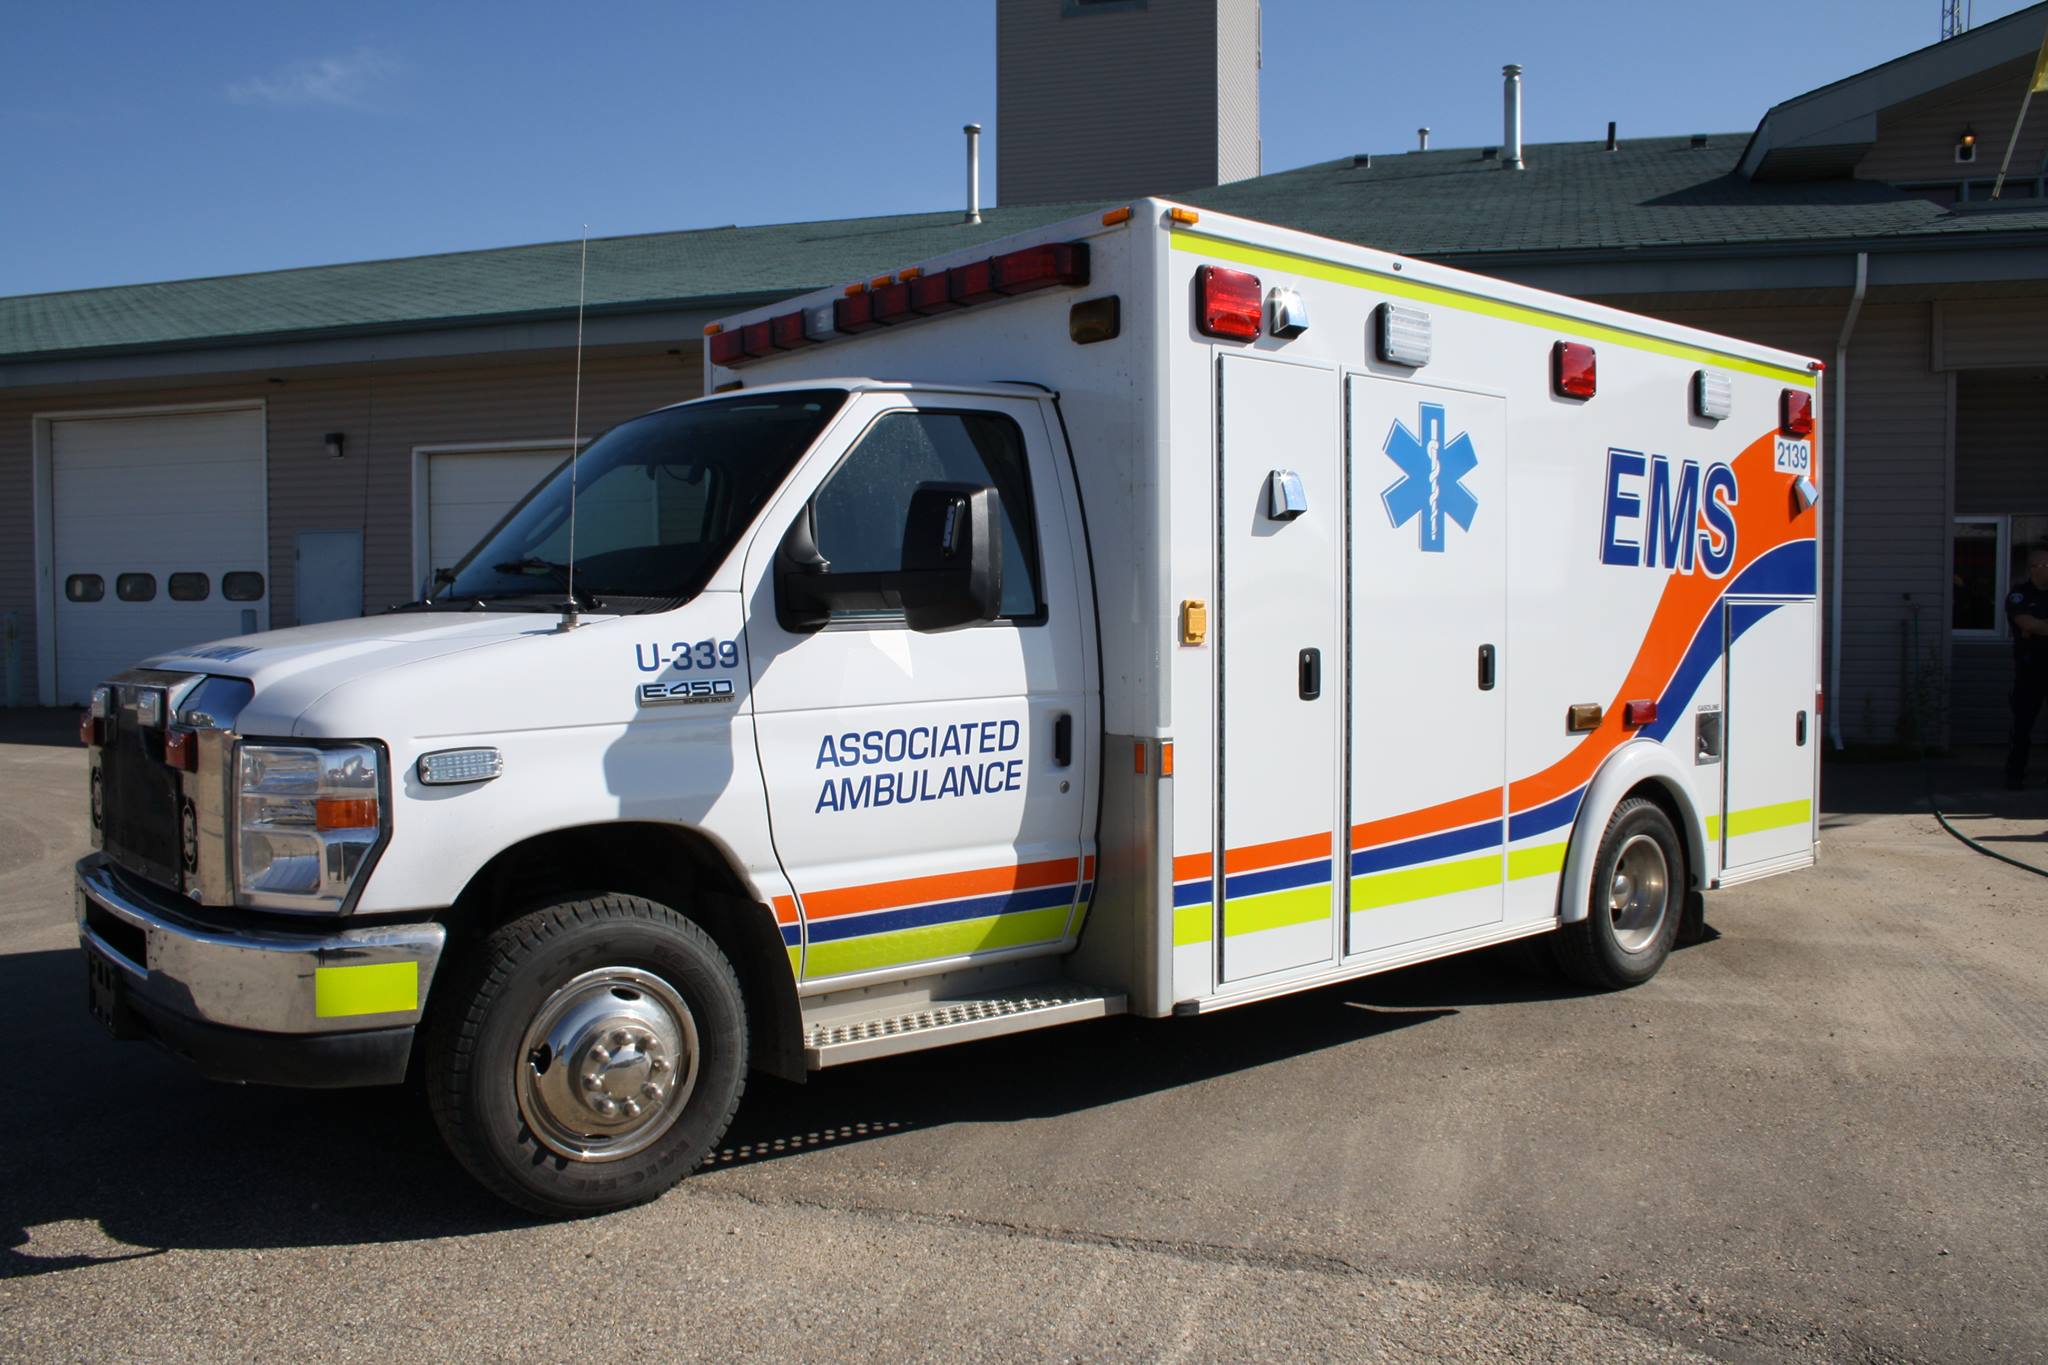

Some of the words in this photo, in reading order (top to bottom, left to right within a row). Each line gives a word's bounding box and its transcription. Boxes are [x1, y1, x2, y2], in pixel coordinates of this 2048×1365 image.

[1776, 441, 1808, 469] 2139
[1600, 447, 1738, 578] EMS
[636, 640, 739, 672] U-339
[642, 680, 733, 698] E-450
[815, 720, 1020, 769] ASSOCIATED
[815, 759, 1024, 814] AMBULANCE
